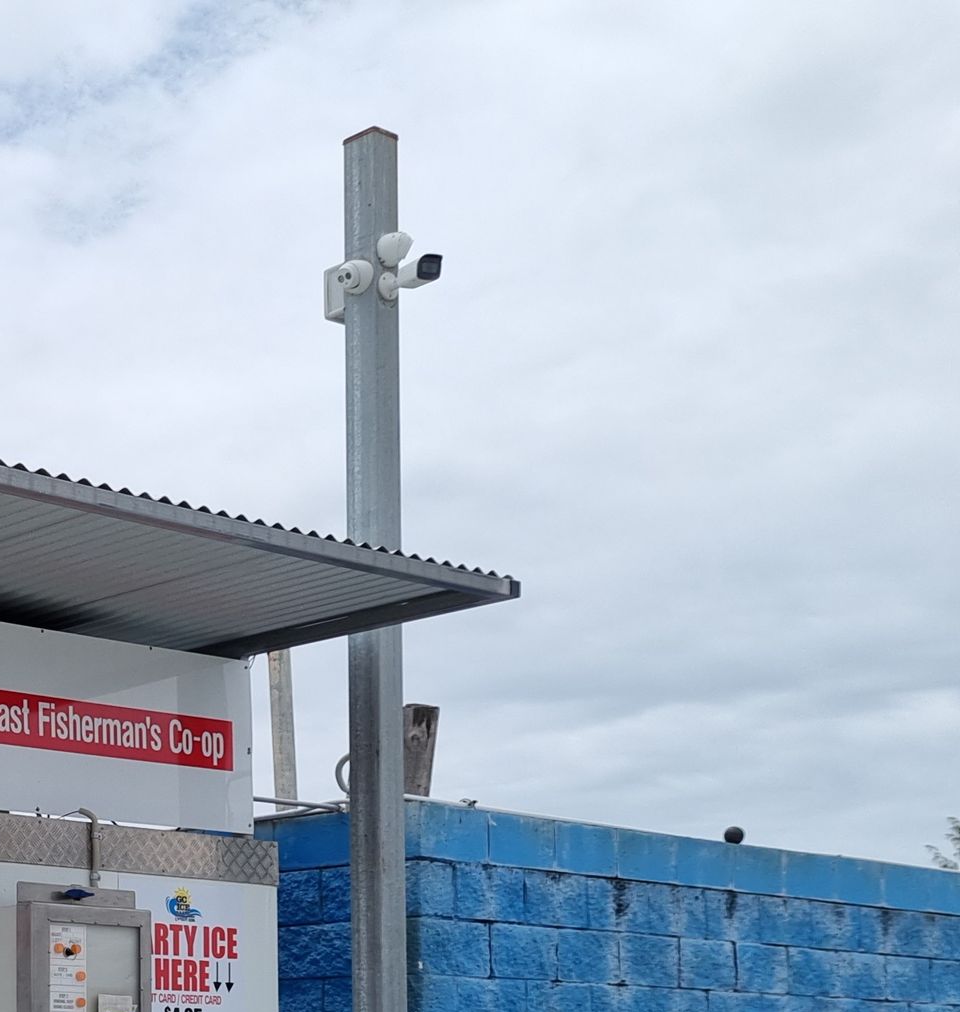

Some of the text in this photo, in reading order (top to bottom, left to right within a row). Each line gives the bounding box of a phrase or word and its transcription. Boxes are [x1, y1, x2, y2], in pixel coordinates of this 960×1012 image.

[37, 701, 162, 751] Fisherman's
[168, 719, 225, 766] Co-op
[151, 922, 238, 959] RTY ICE
[154, 958, 210, 992] HERE
[158, 993, 176, 1003] CARD
[181, 994, 203, 1004] CREDIT
[205, 995, 222, 1005] CARD
